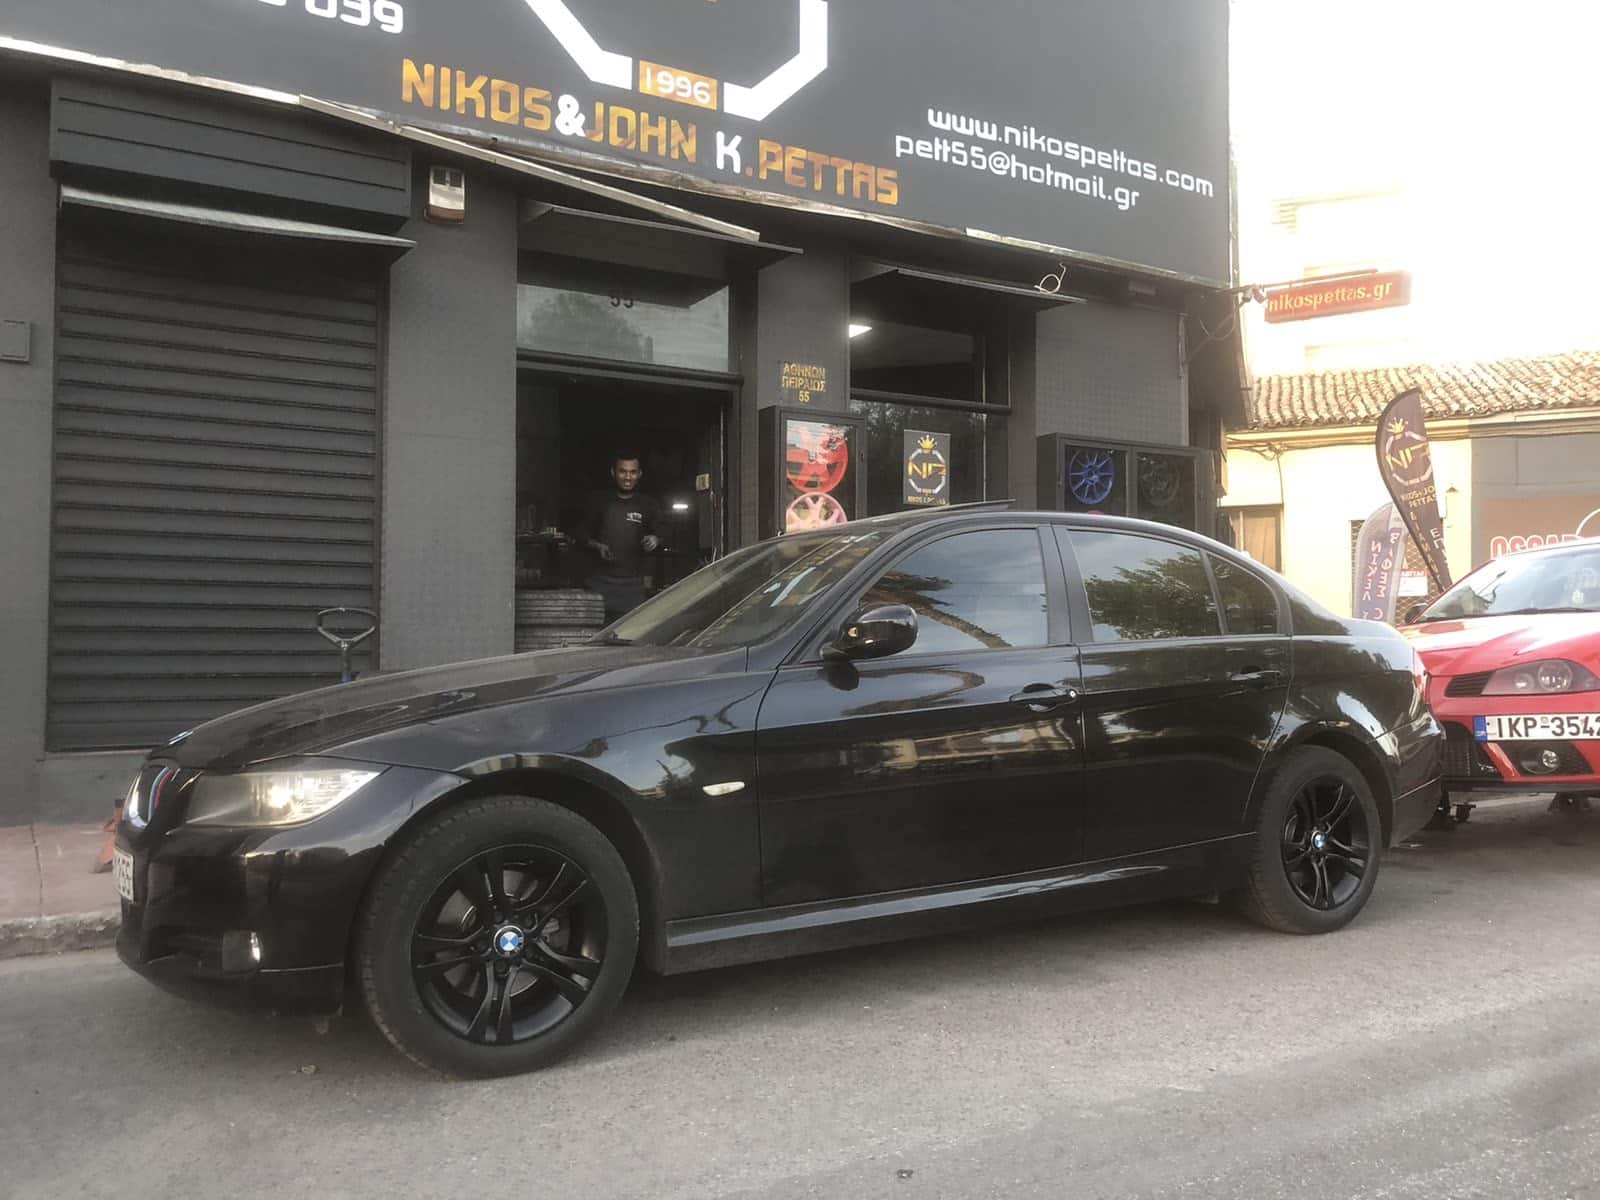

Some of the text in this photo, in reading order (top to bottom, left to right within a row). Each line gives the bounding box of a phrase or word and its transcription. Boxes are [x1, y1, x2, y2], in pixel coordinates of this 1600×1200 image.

[645, 66, 712, 105] 1996
[895, 134, 1140, 211] pett55@hotmail.gr
[927, 107, 1215, 198] www.nikospettas.com
[1267, 282, 1393, 313] nikospettas.gr
